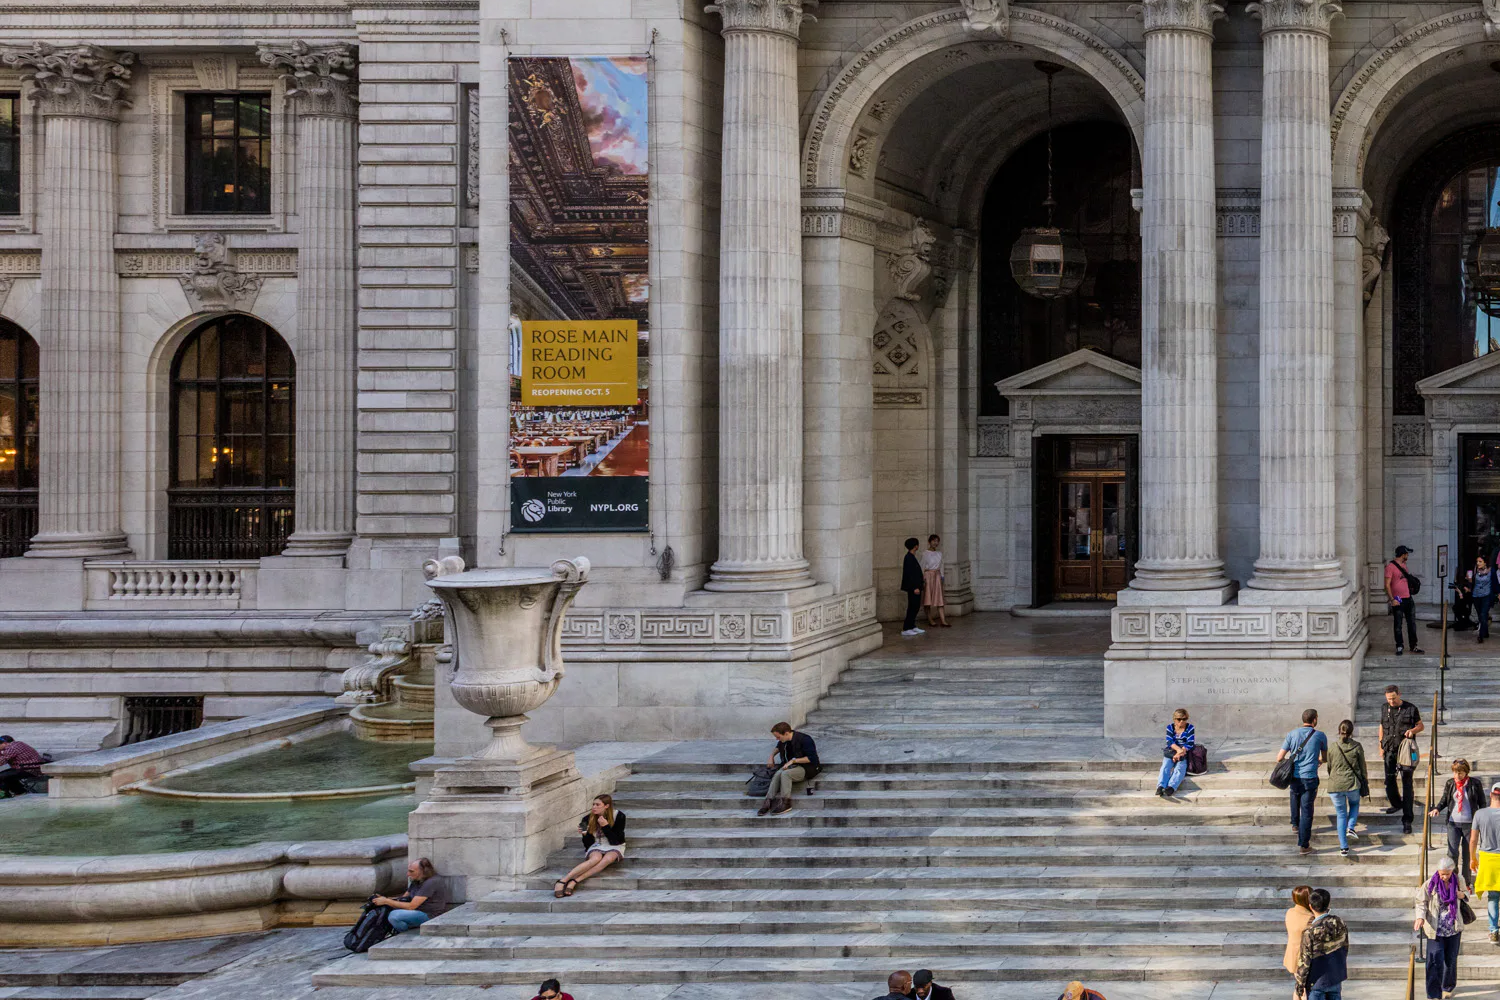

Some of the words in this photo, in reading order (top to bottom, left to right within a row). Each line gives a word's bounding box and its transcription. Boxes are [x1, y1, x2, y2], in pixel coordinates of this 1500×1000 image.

[531, 329, 577, 344] ROSE
[583, 329, 629, 343] MAIN
[531, 347, 613, 361] READING
[531, 365, 586, 380] ROOM
[531, 388, 583, 396] REOPENING
[584, 388, 603, 396] OCT.
[605, 388, 610, 396] 5
[547, 505, 573, 513] Library
[590, 503, 639, 512] NYPL.ORG
